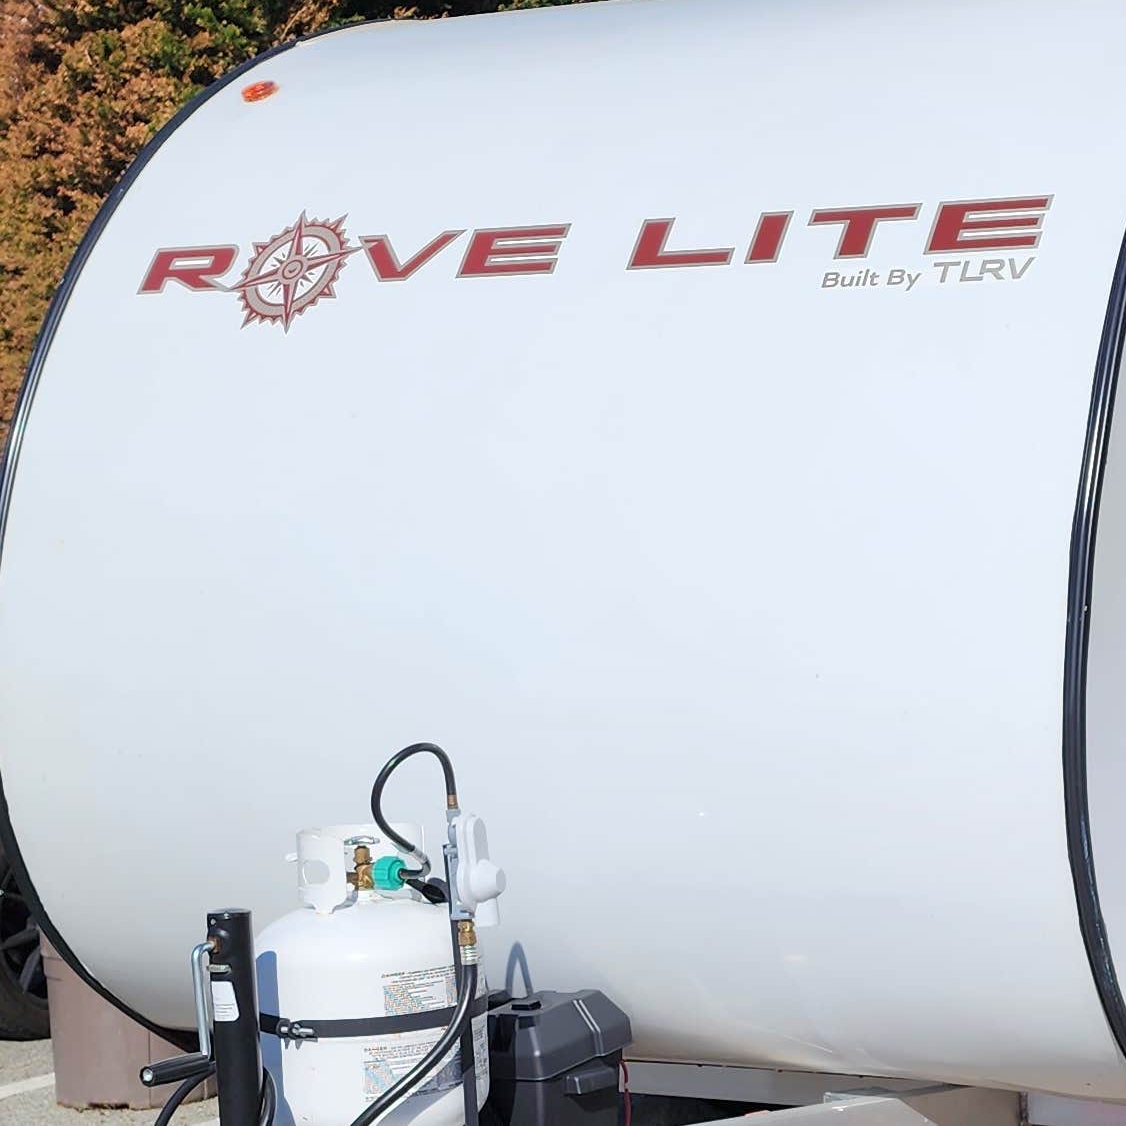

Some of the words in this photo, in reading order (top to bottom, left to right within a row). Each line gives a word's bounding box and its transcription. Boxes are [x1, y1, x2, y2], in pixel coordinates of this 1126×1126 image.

[626, 194, 1055, 270] LITE
[821, 268, 879, 289] Built
[886, 268, 922, 292] By
[932, 256, 1036, 284] TLRV
